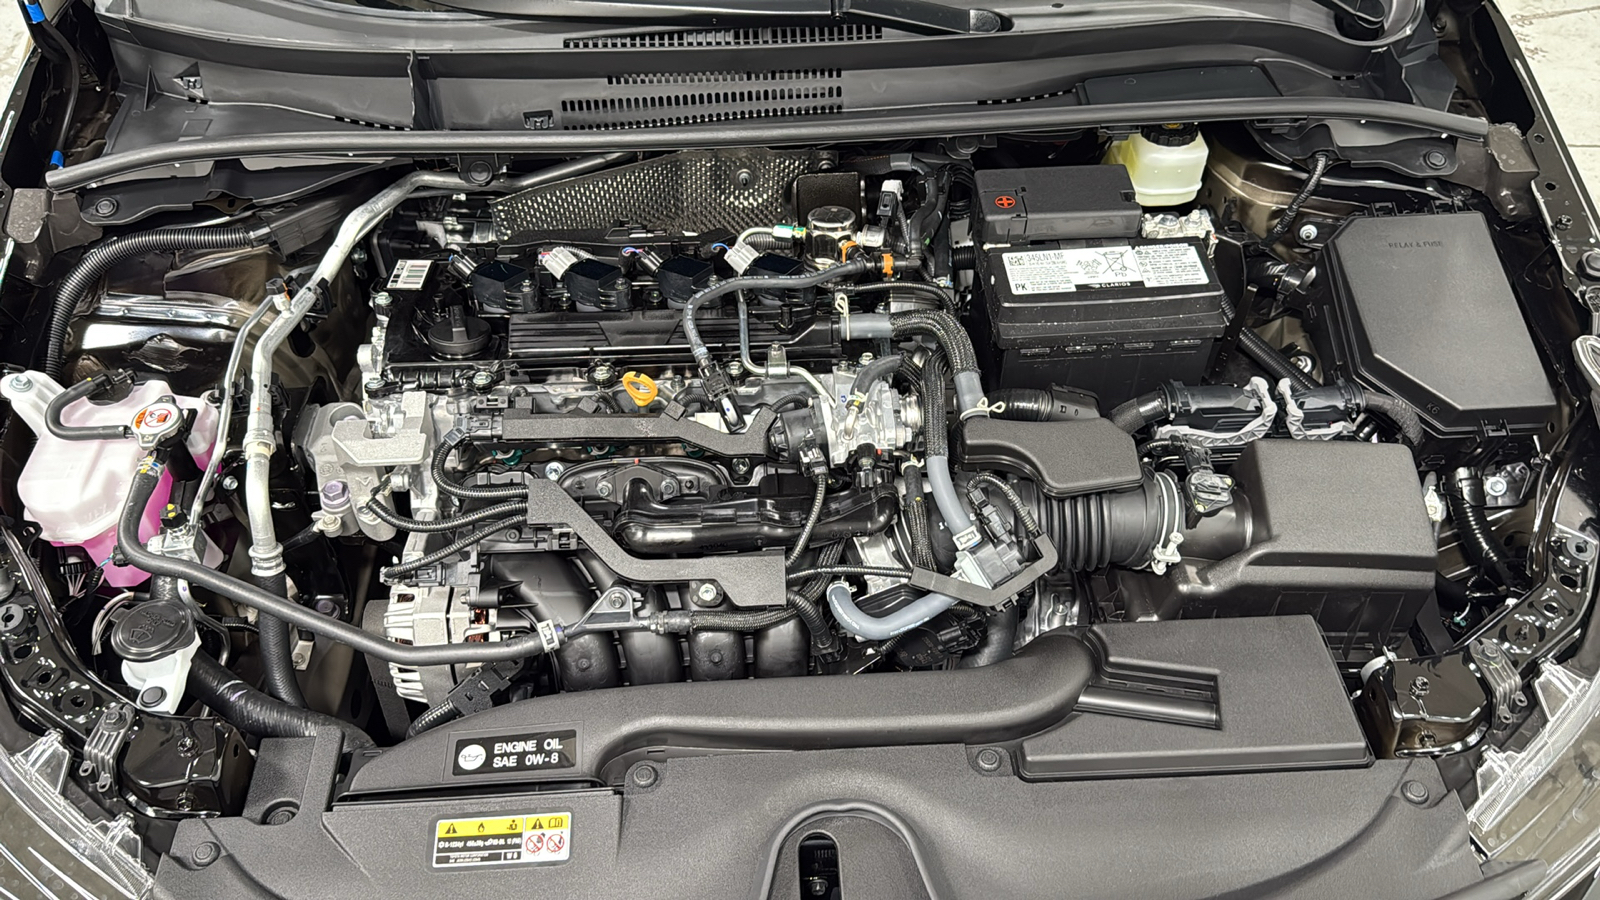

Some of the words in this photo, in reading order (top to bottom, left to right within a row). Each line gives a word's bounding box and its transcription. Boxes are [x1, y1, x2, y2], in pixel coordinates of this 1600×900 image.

[1423, 240, 1443, 248] FUSE
[1015, 283, 1027, 291] PK
[493, 740, 537, 754] ENGINE
[543, 738, 563, 751] OIL
[492, 755, 518, 768] SAE
[525, 752, 559, 766] 0W-8
